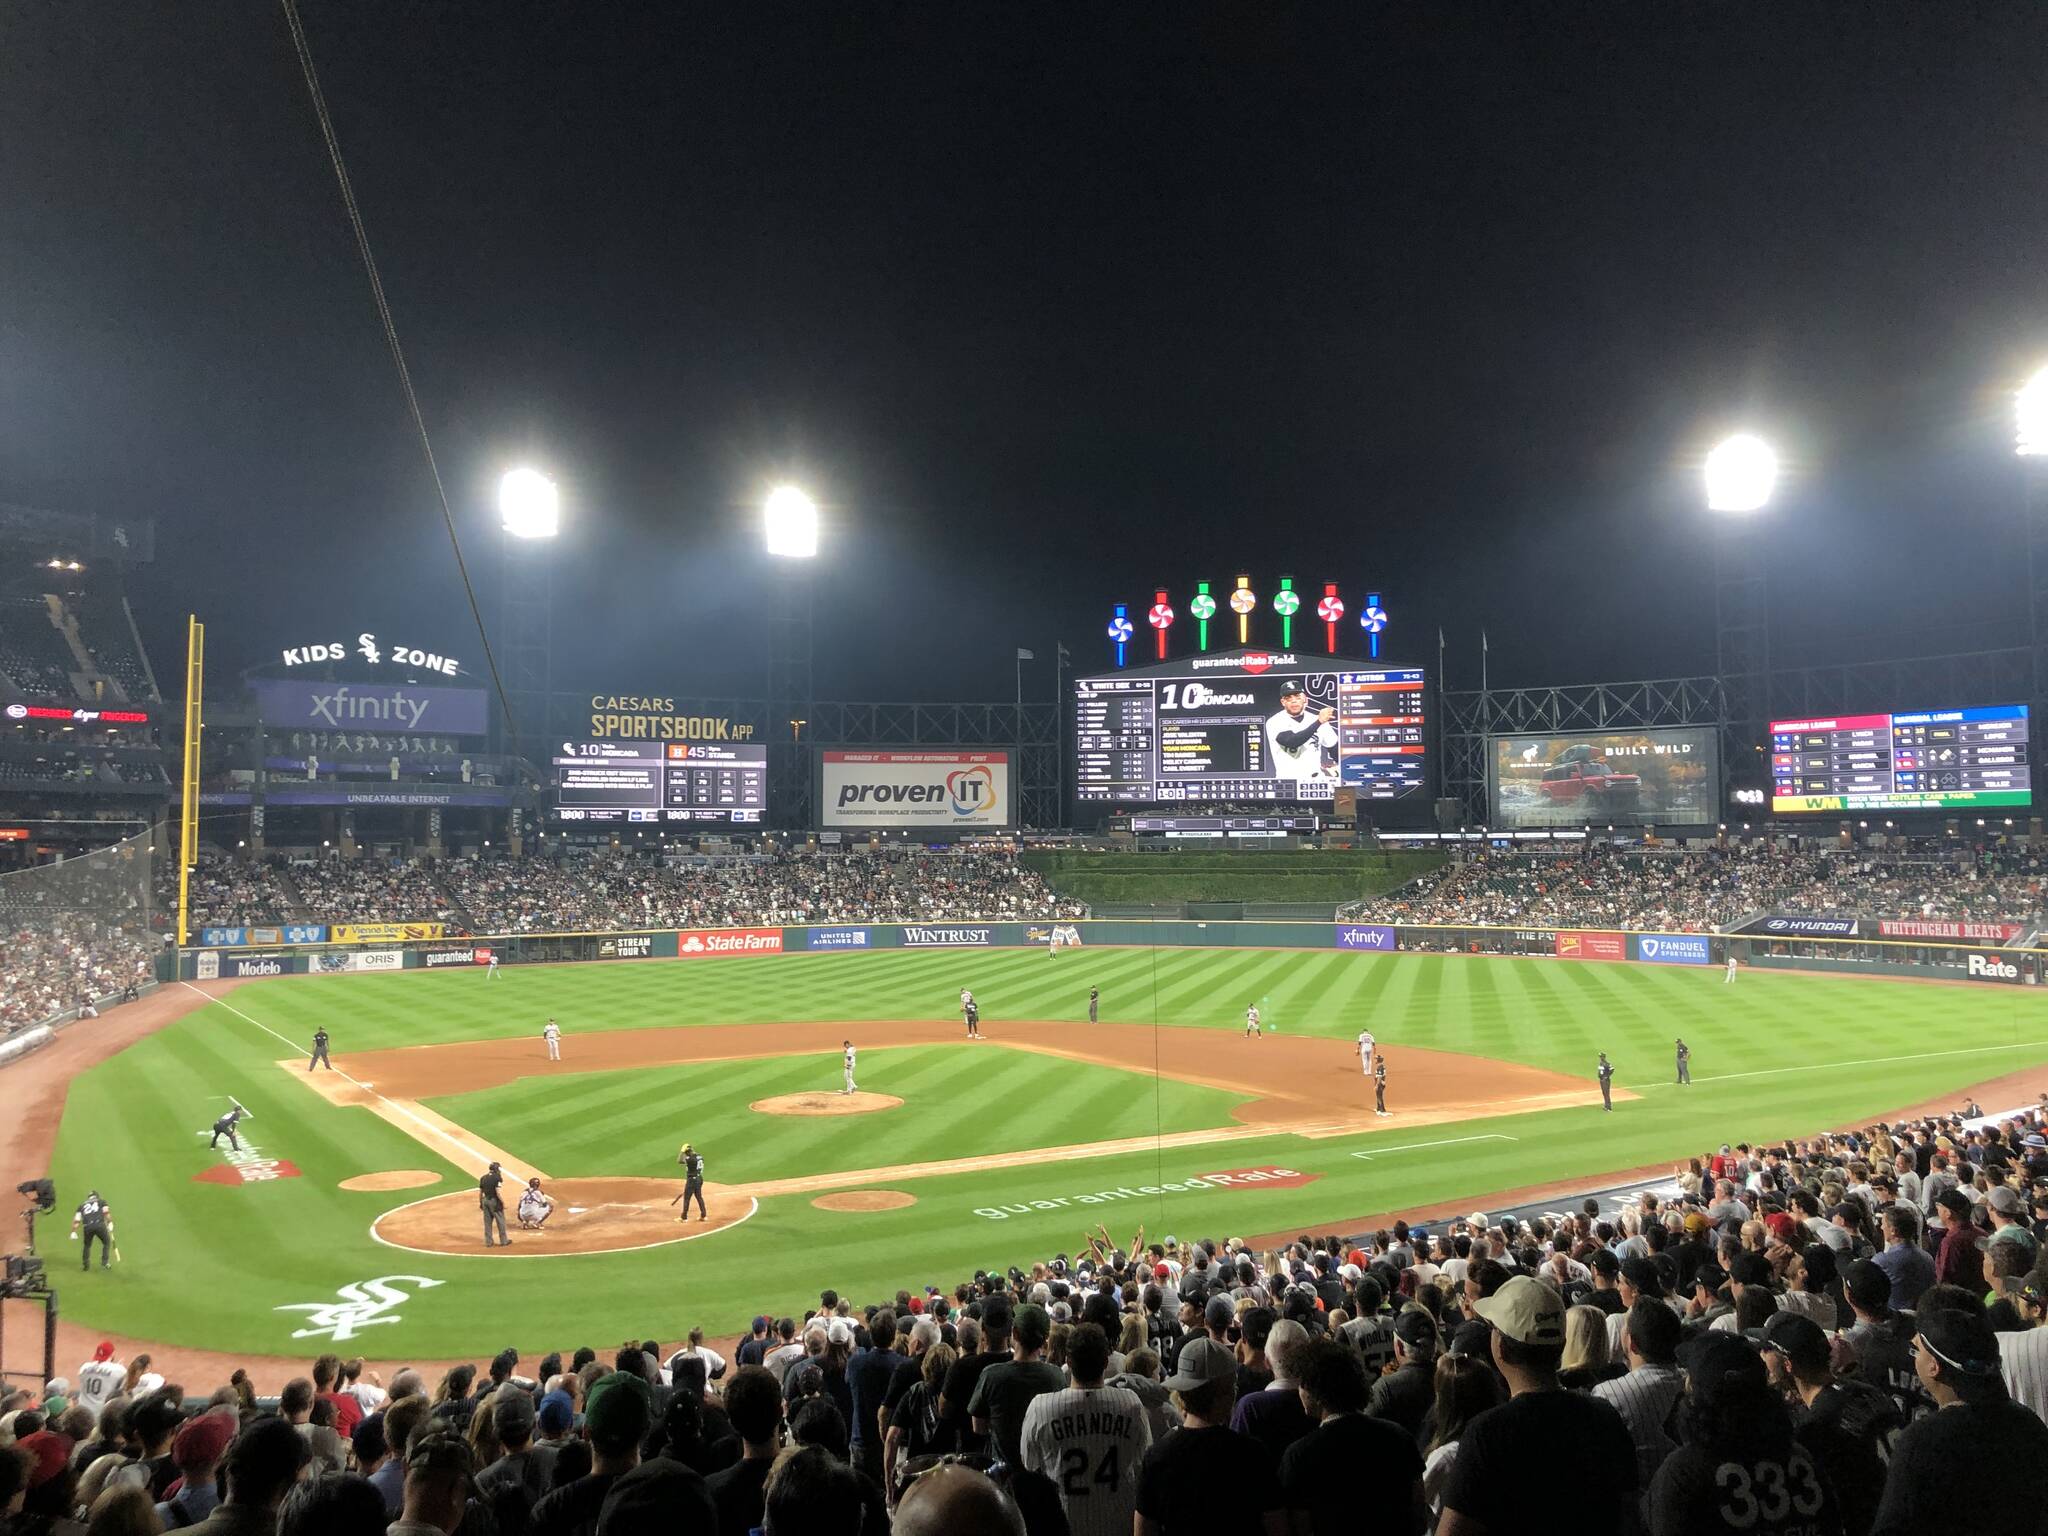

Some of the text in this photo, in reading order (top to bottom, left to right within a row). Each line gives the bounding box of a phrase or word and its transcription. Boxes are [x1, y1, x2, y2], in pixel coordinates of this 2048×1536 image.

[283, 643, 459, 676] KIDS ZONE
[1193, 657, 1245, 669] guaranteed
[1246, 655, 1267, 665] Rate
[1160, 683, 1204, 709] 10
[310, 687, 429, 729] xfinity
[591, 696, 674, 712] CAESARS
[591, 715, 753, 740] SPORTSBOOK APP
[580, 744, 599, 756] 10
[688, 747, 706, 758] 45
[1605, 744, 1691, 757] BUILT WILD
[347, 795, 450, 805] UNBEATABLE INTERNET
[838, 780, 983, 807] proven IT
[1159, 790, 1174, 798] 1-0
[1805, 798, 1842, 809] WM
[351, 926, 382, 934] Vienna
[1789, 920, 1849, 932] HYUNDAI
[1881, 921, 2002, 938] WHITTINGHAM MEATS
[618, 938, 651, 947] STREAM
[904, 927, 989, 943] WINTRUST
[1343, 928, 1384, 946] xfinity
[1515, 931, 1535, 940] THE
[618, 947, 639, 956] YOUR
[1660, 942, 1705, 952] FANDUEL
[365, 954, 395, 965] ORIS
[427, 950, 473, 967] guaranteed
[1968, 954, 2018, 978] Rate
[238, 961, 281, 976] Modelo
[973, 1166, 1301, 1220] guaranteed Rate
[83, 1201, 100, 1215] 24
[86, 1377, 102, 1396] 10
[1051, 1413, 1132, 1441] GRANDAL
[1062, 1444, 1119, 1496] 24
[1715, 1454, 1823, 1528] 333
